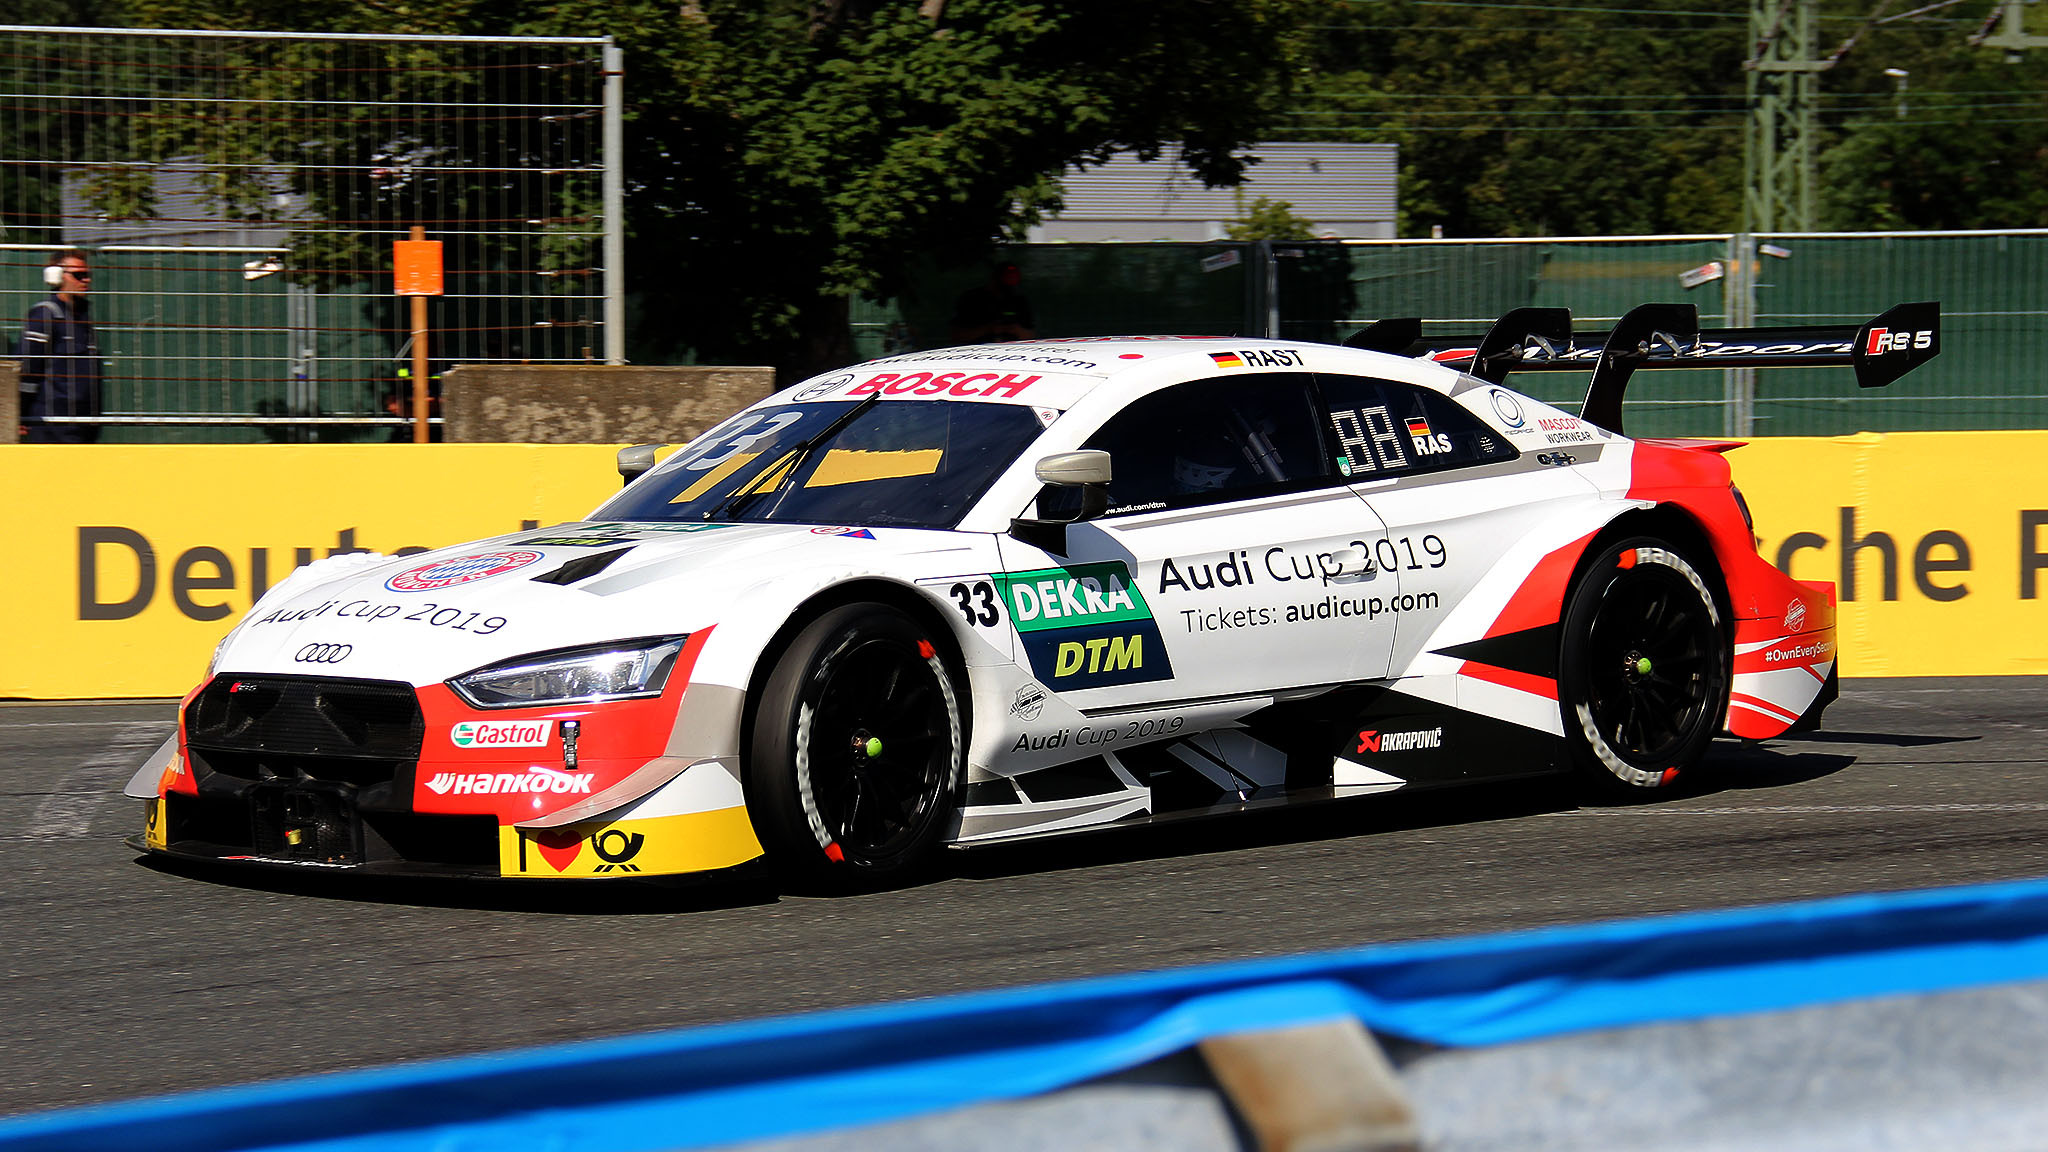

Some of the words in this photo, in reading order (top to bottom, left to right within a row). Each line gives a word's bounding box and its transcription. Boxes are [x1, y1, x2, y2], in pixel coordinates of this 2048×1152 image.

[1914, 330, 1933, 349] 5
[1239, 349, 1304, 366] RAST
[845, 372, 1042, 398] BOSCH
[653, 412, 803, 475] 33
[1411, 433, 1453, 456] RAS
[1545, 432, 1594, 444] WORKWEAR
[1159, 550, 1254, 594] Audi
[1265, 547, 1343, 587] Cup
[1350, 534, 1447, 573] 2019
[950, 581, 999, 627] 33
[1012, 573, 1135, 622] DEKRA
[1180, 605, 1277, 633] Tickets:
[1286, 591, 1439, 623] audicup.com
[252, 600, 339, 627] Audi
[337, 600, 400, 622] Cup
[404, 603, 507, 634] 2019
[1054, 634, 1142, 677] DTM
[476, 724, 544, 744] Castrol
[1011, 728, 1069, 753] Audi
[1075, 726, 1118, 747] Cup
[1123, 717, 1184, 740] 2019
